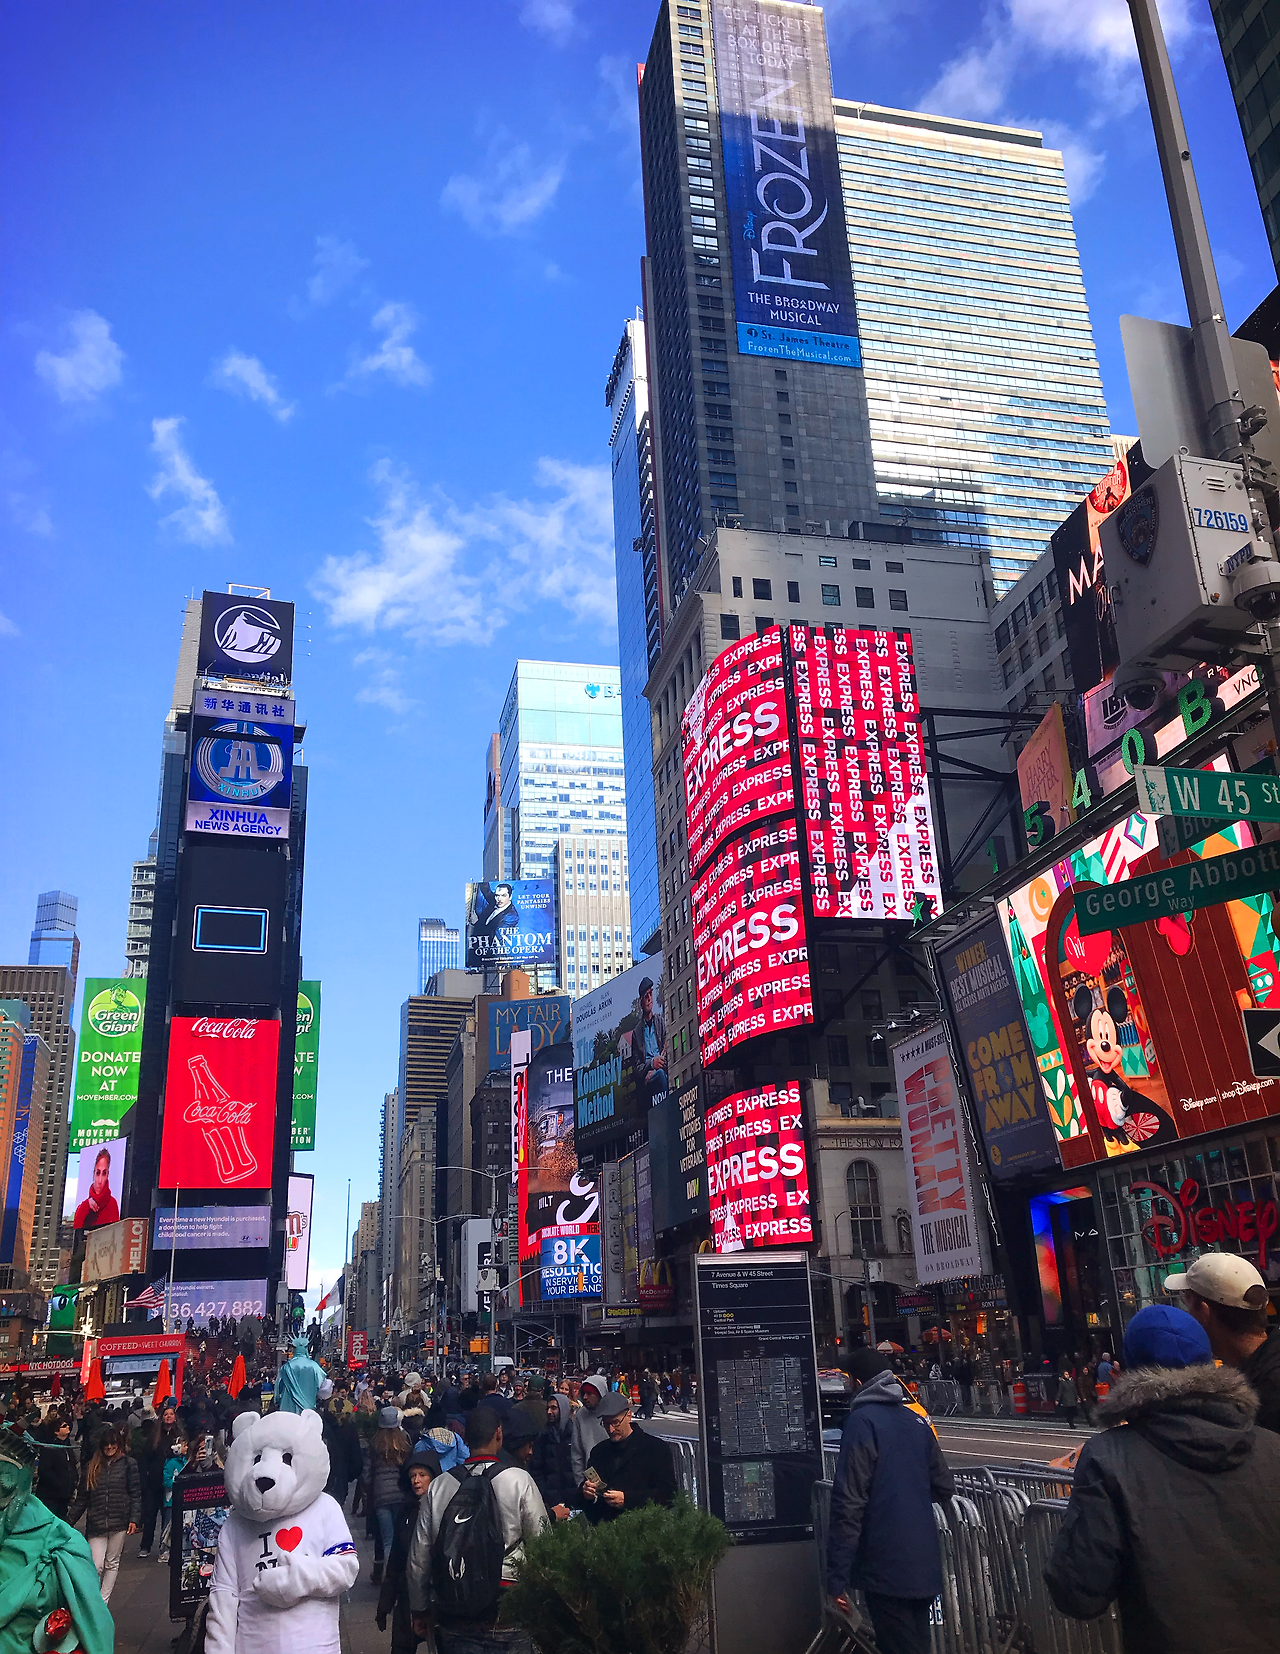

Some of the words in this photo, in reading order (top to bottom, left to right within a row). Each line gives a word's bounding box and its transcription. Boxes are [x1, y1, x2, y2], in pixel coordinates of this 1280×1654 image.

[723, 6, 750, 21] GET
[757, 11, 811, 33] TICKETS
[742, 24, 758, 37] AT
[762, 27, 790, 43] THE
[728, 34, 756, 50] BOX
[762, 41, 811, 60] OFFICE
[749, 52, 793, 70] TODAY
[742, 73, 831, 291] FROZEN
[747, 291, 771, 305] THE
[775, 296, 840, 314] BROADWAY
[770, 310, 822, 326] MUSICAL
[748, 341, 851, 362] FrozenTheMusical.com
[762, 330, 775, 340] St.
[780, 333, 808, 345] James
[813, 337, 850, 350] Theatre
[895, 640, 914, 713] EXPRESS
[204, 697, 285, 718] 新华通讯社
[687, 702, 779, 802] EXPRESS
[864, 719, 883, 795] EXPRESS
[877, 666, 897, 739] EXPRESS
[887, 747, 907, 824] EXPRESS
[904, 721, 924, 798] EXPRESS
[217, 782, 267, 798] XINHUA
[1173, 775, 1200, 811] W
[1218, 779, 1251, 815] 45
[1262, 781, 1280, 804] St
[195, 819, 229, 832] NEWS
[232, 822, 282, 836] AGENCY
[208, 807, 269, 825] XINHUA
[737, 826, 798, 859] EXPRESS
[872, 803, 894, 883] EXPRESS
[914, 806, 934, 884] EXPRESS
[718, 865, 754, 900] EXPRESS
[741, 877, 802, 908] EXPRESS
[1086, 876, 1175, 916] George
[1189, 849, 1280, 891] Abbott
[1168, 893, 1195, 911] Way
[468, 932, 552, 950] PHANTOM
[499, 927, 520, 935] THE
[475, 948, 488, 956] OF
[492, 946, 511, 955] THE
[511, 945, 545, 954] OPERA
[697, 903, 799, 991] EXPRESS
[724, 958, 761, 991] EXPRESS
[949, 974, 970, 1002] BEST
[968, 954, 1006, 992] MUSICAL
[747, 973, 811, 1002] EXPRESS
[94, 1009, 138, 1022] Green
[495, 1007, 521, 1025] MY
[527, 1003, 561, 1023] FAIR
[576, 1004, 597, 1024] DOUGLAS
[98, 1021, 139, 1034] Giant
[191, 1017, 260, 1040] Coca-Cola
[728, 1013, 765, 1043] EXPRESS
[967, 1019, 1024, 1071] COME
[81, 1052, 141, 1063] DONATE
[91, 1066, 129, 1077] NOW
[547, 1068, 573, 1084] THE
[577, 1053, 623, 1099] Kominsky
[15, 1050, 36, 1121] NOVOTEL
[99, 1080, 118, 1091] AT
[577, 1086, 615, 1130] Method
[679, 1085, 698, 1111] SUPPORT
[737, 1088, 801, 1114] EXPRESS
[984, 1082, 1038, 1134] AWAY
[1204, 1096, 1217, 1105] store
[183, 1100, 257, 1124] Coca-Cola
[683, 1104, 696, 1124] MORE
[679, 1117, 702, 1142] VICTORIES
[725, 1119, 771, 1144] EXPRESS
[780, 1114, 803, 1131] EX
[903, 1066, 942, 1216] WOMAN
[923, 1055, 967, 1213] PRETTY
[686, 1136, 696, 1153] FOR
[834, 1138, 853, 1148] THE
[856, 1138, 884, 1148] SHOW
[708, 1143, 804, 1197] EXPRESS
[787, 1189, 810, 1207] EX
[195, 1223, 208, 1231] help
[745, 1217, 812, 1240] EXPRESS
[920, 1221, 934, 1256] THE
[934, 1214, 972, 1253] MUSICAL
[129, 1221, 143, 1271] HELLO!
[553, 1238, 590, 1265] 8K
[925, 1262, 934, 1273] ON
[934, 1257, 975, 1271] BROADWAY
[546, 1285, 567, 1296] YOUR
[942, 1279, 964, 1296] GIFTS
[968, 1273, 1006, 1292] LUGGAGE
[981, 1301, 995, 1309] SONY
[100, 1342, 139, 1352] COFFEED
[28, 1361, 42, 1371] NYC
[42, 1358, 74, 1370] HOTDOGS
[258, 1531, 272, 1559] I
